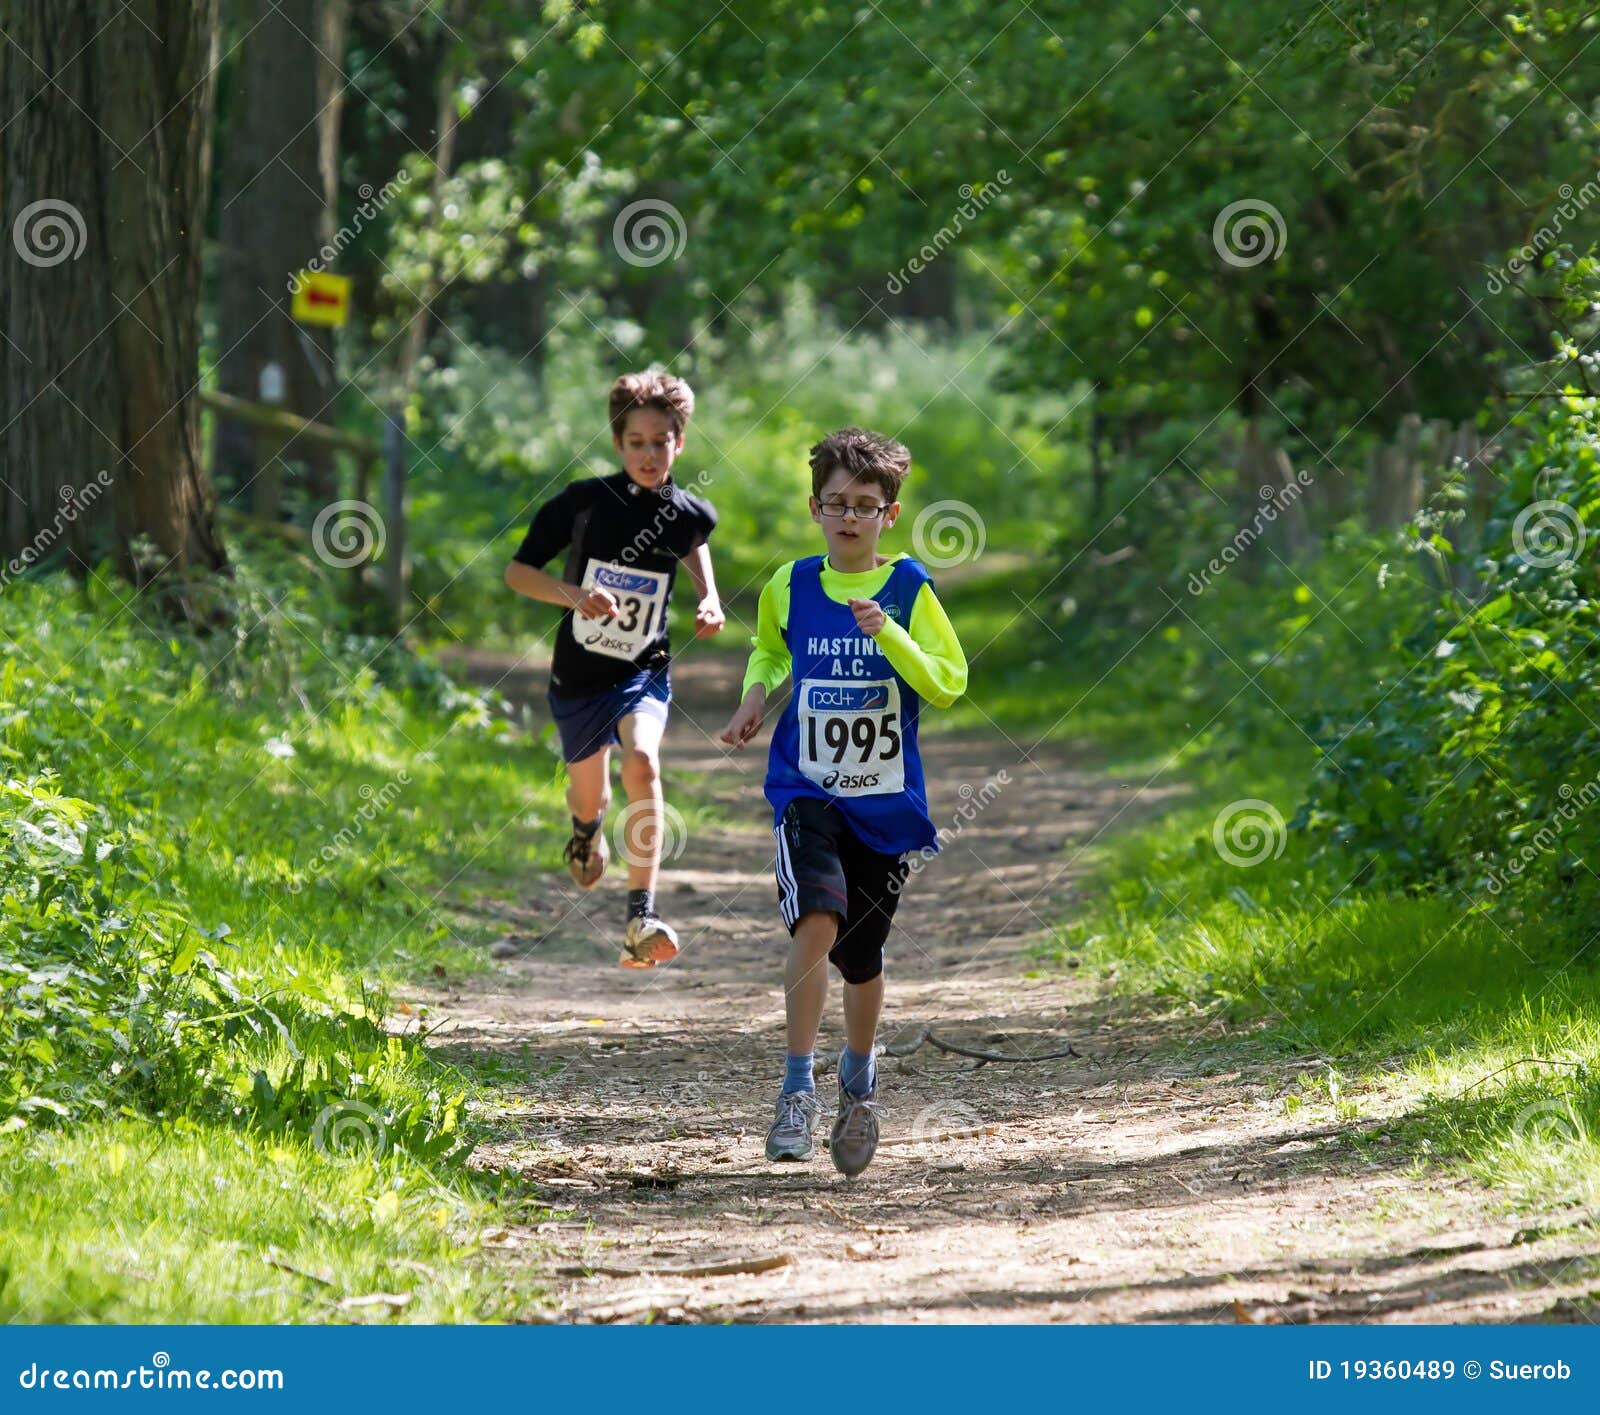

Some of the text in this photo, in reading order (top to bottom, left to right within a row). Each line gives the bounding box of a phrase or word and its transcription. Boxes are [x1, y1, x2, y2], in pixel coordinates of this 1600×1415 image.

[831, 658, 871, 677] A.C.
[808, 713, 901, 764] 1995
[840, 772, 880, 789] asics
